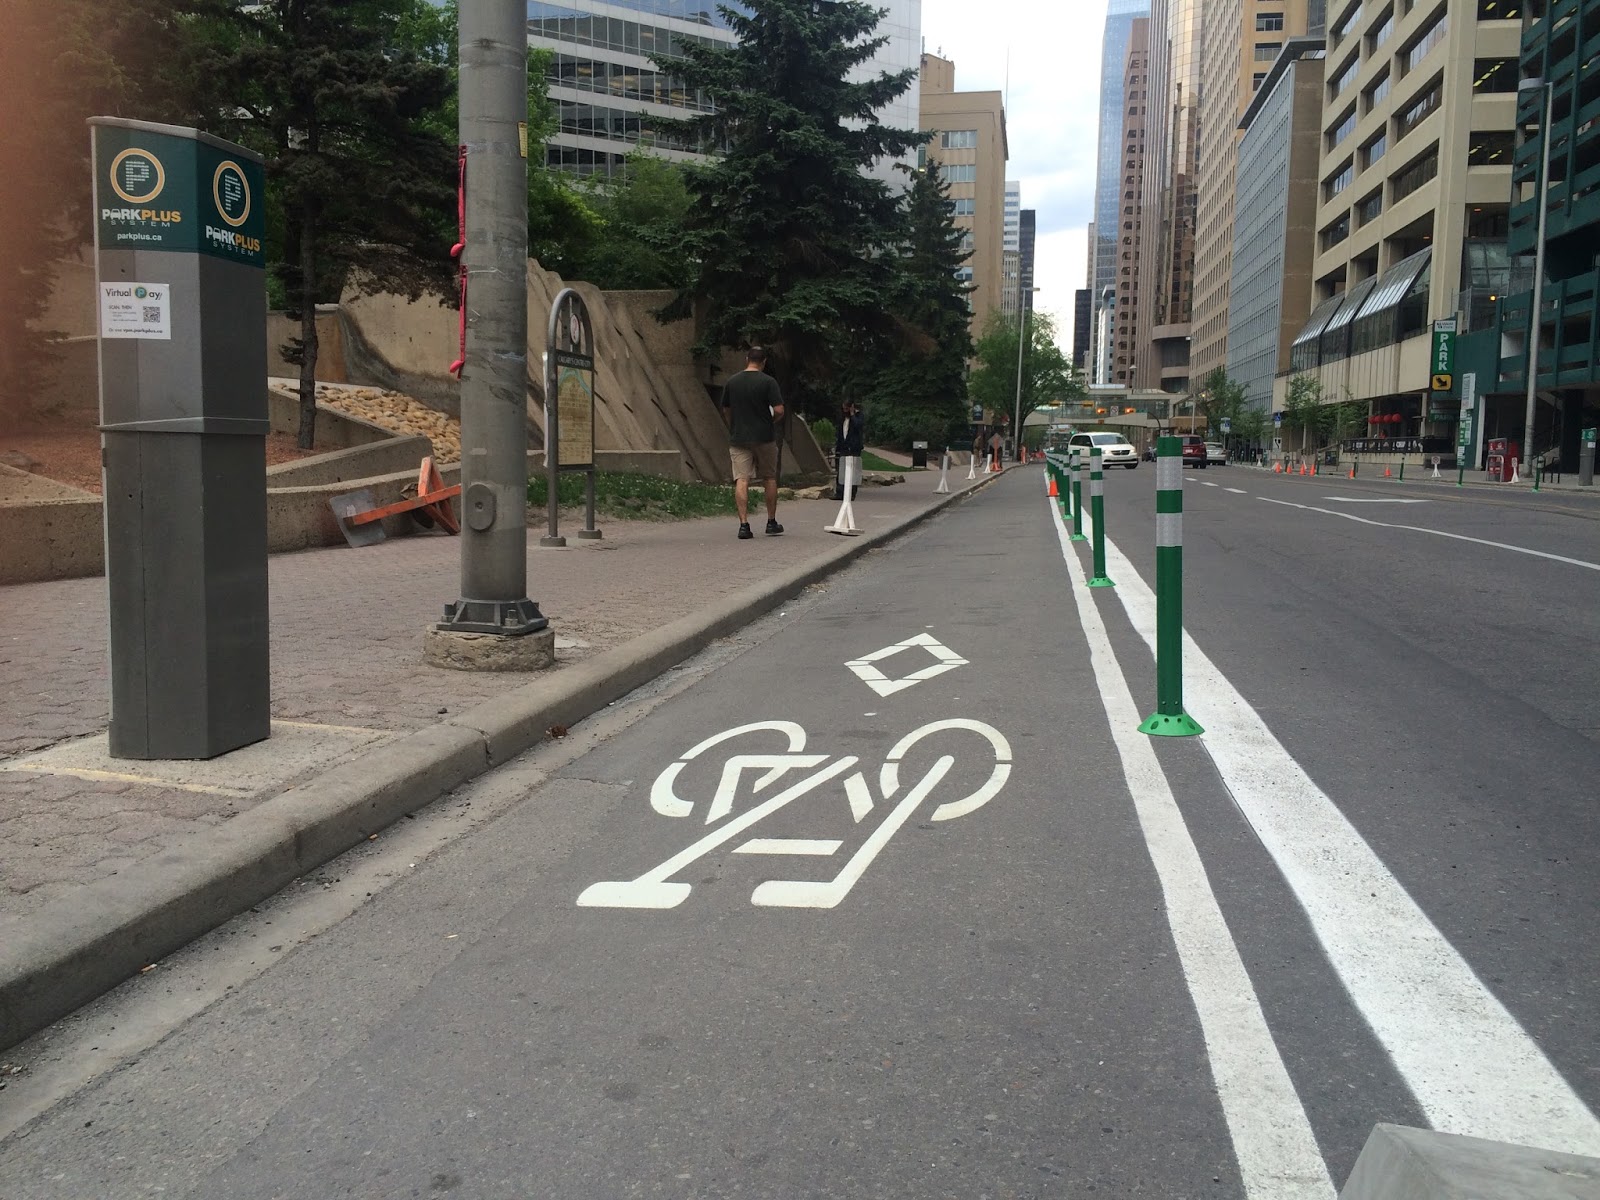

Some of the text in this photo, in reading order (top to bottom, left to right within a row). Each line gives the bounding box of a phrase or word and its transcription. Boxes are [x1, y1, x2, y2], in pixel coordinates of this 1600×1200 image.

[110, 219, 171, 228] SYSTEM
[117, 232, 162, 241] parkplus.ca
[213, 240, 254, 257] SYSTEM
[105, 287, 132, 297] Virtual
[1438, 333, 1449, 371] PARK
